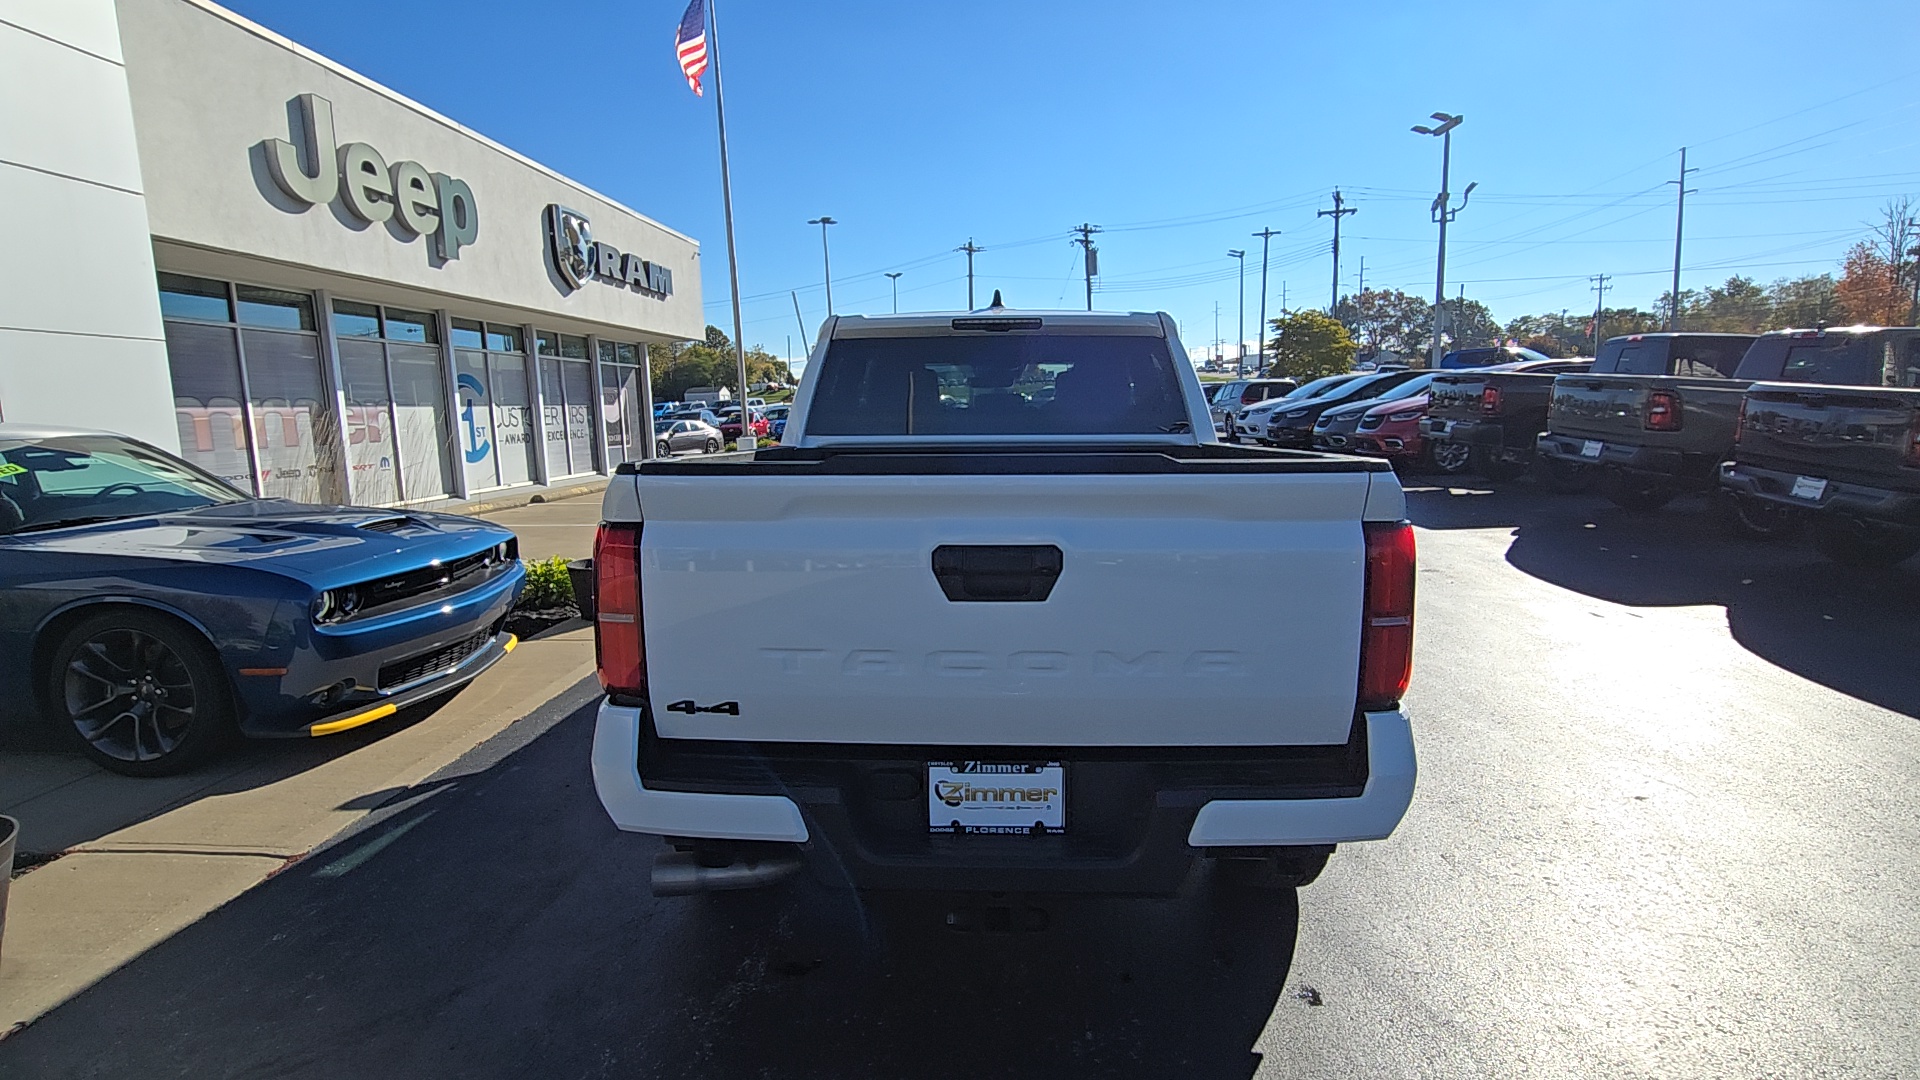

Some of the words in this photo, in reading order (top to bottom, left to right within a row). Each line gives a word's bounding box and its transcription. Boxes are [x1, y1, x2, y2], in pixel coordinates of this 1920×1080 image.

[265, 93, 479, 261] Jeep
[599, 242, 673, 297] RAM
[504, 432, 532, 445] AWARD
[275, 467, 301, 480] Jeep
[352, 463, 376, 472] SRT
[757, 647, 1248, 676] TACOMA
[964, 760, 1029, 773] Zimmer
[942, 781, 1058, 803] Zimmer
[965, 826, 1031, 834] FLORENCE
